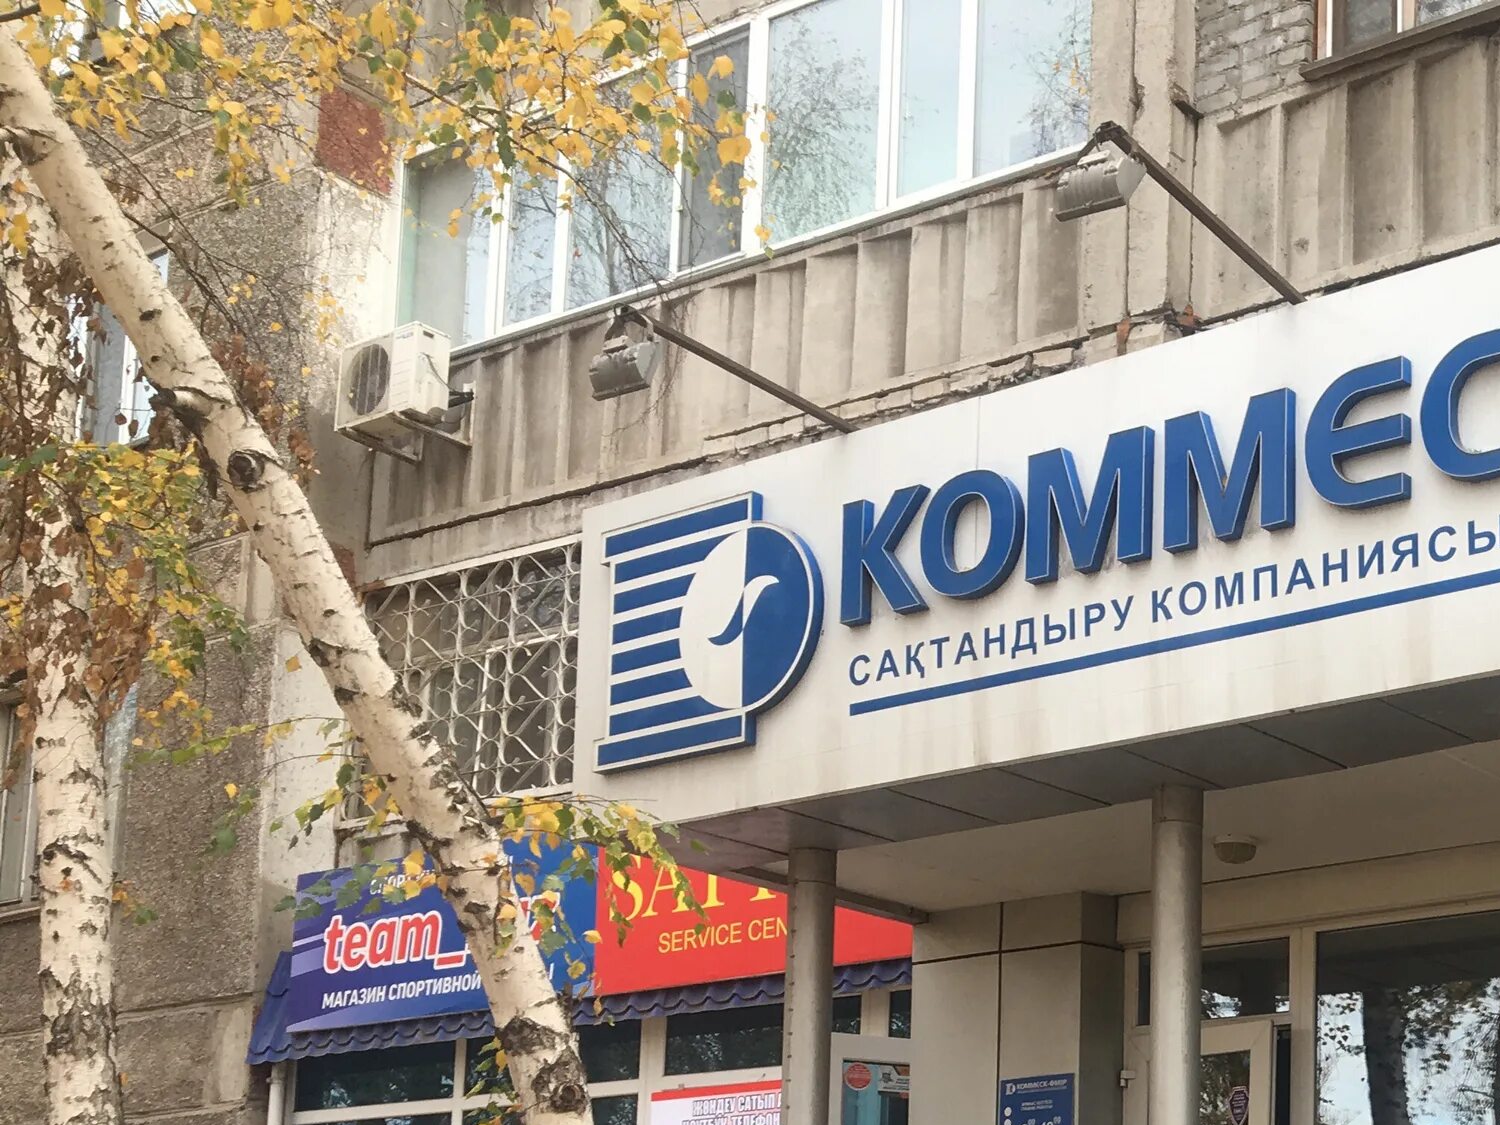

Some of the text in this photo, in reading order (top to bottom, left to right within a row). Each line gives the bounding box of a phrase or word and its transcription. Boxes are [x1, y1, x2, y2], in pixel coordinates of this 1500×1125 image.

[848, 597, 1134, 687] САҚТАНДЫРУ
[658, 921, 742, 954] SERVICE
[321, 970, 481, 1009] МАГАЗИН СПОРТИВНОЙ
[737, 1092, 775, 1112] САТЫП
